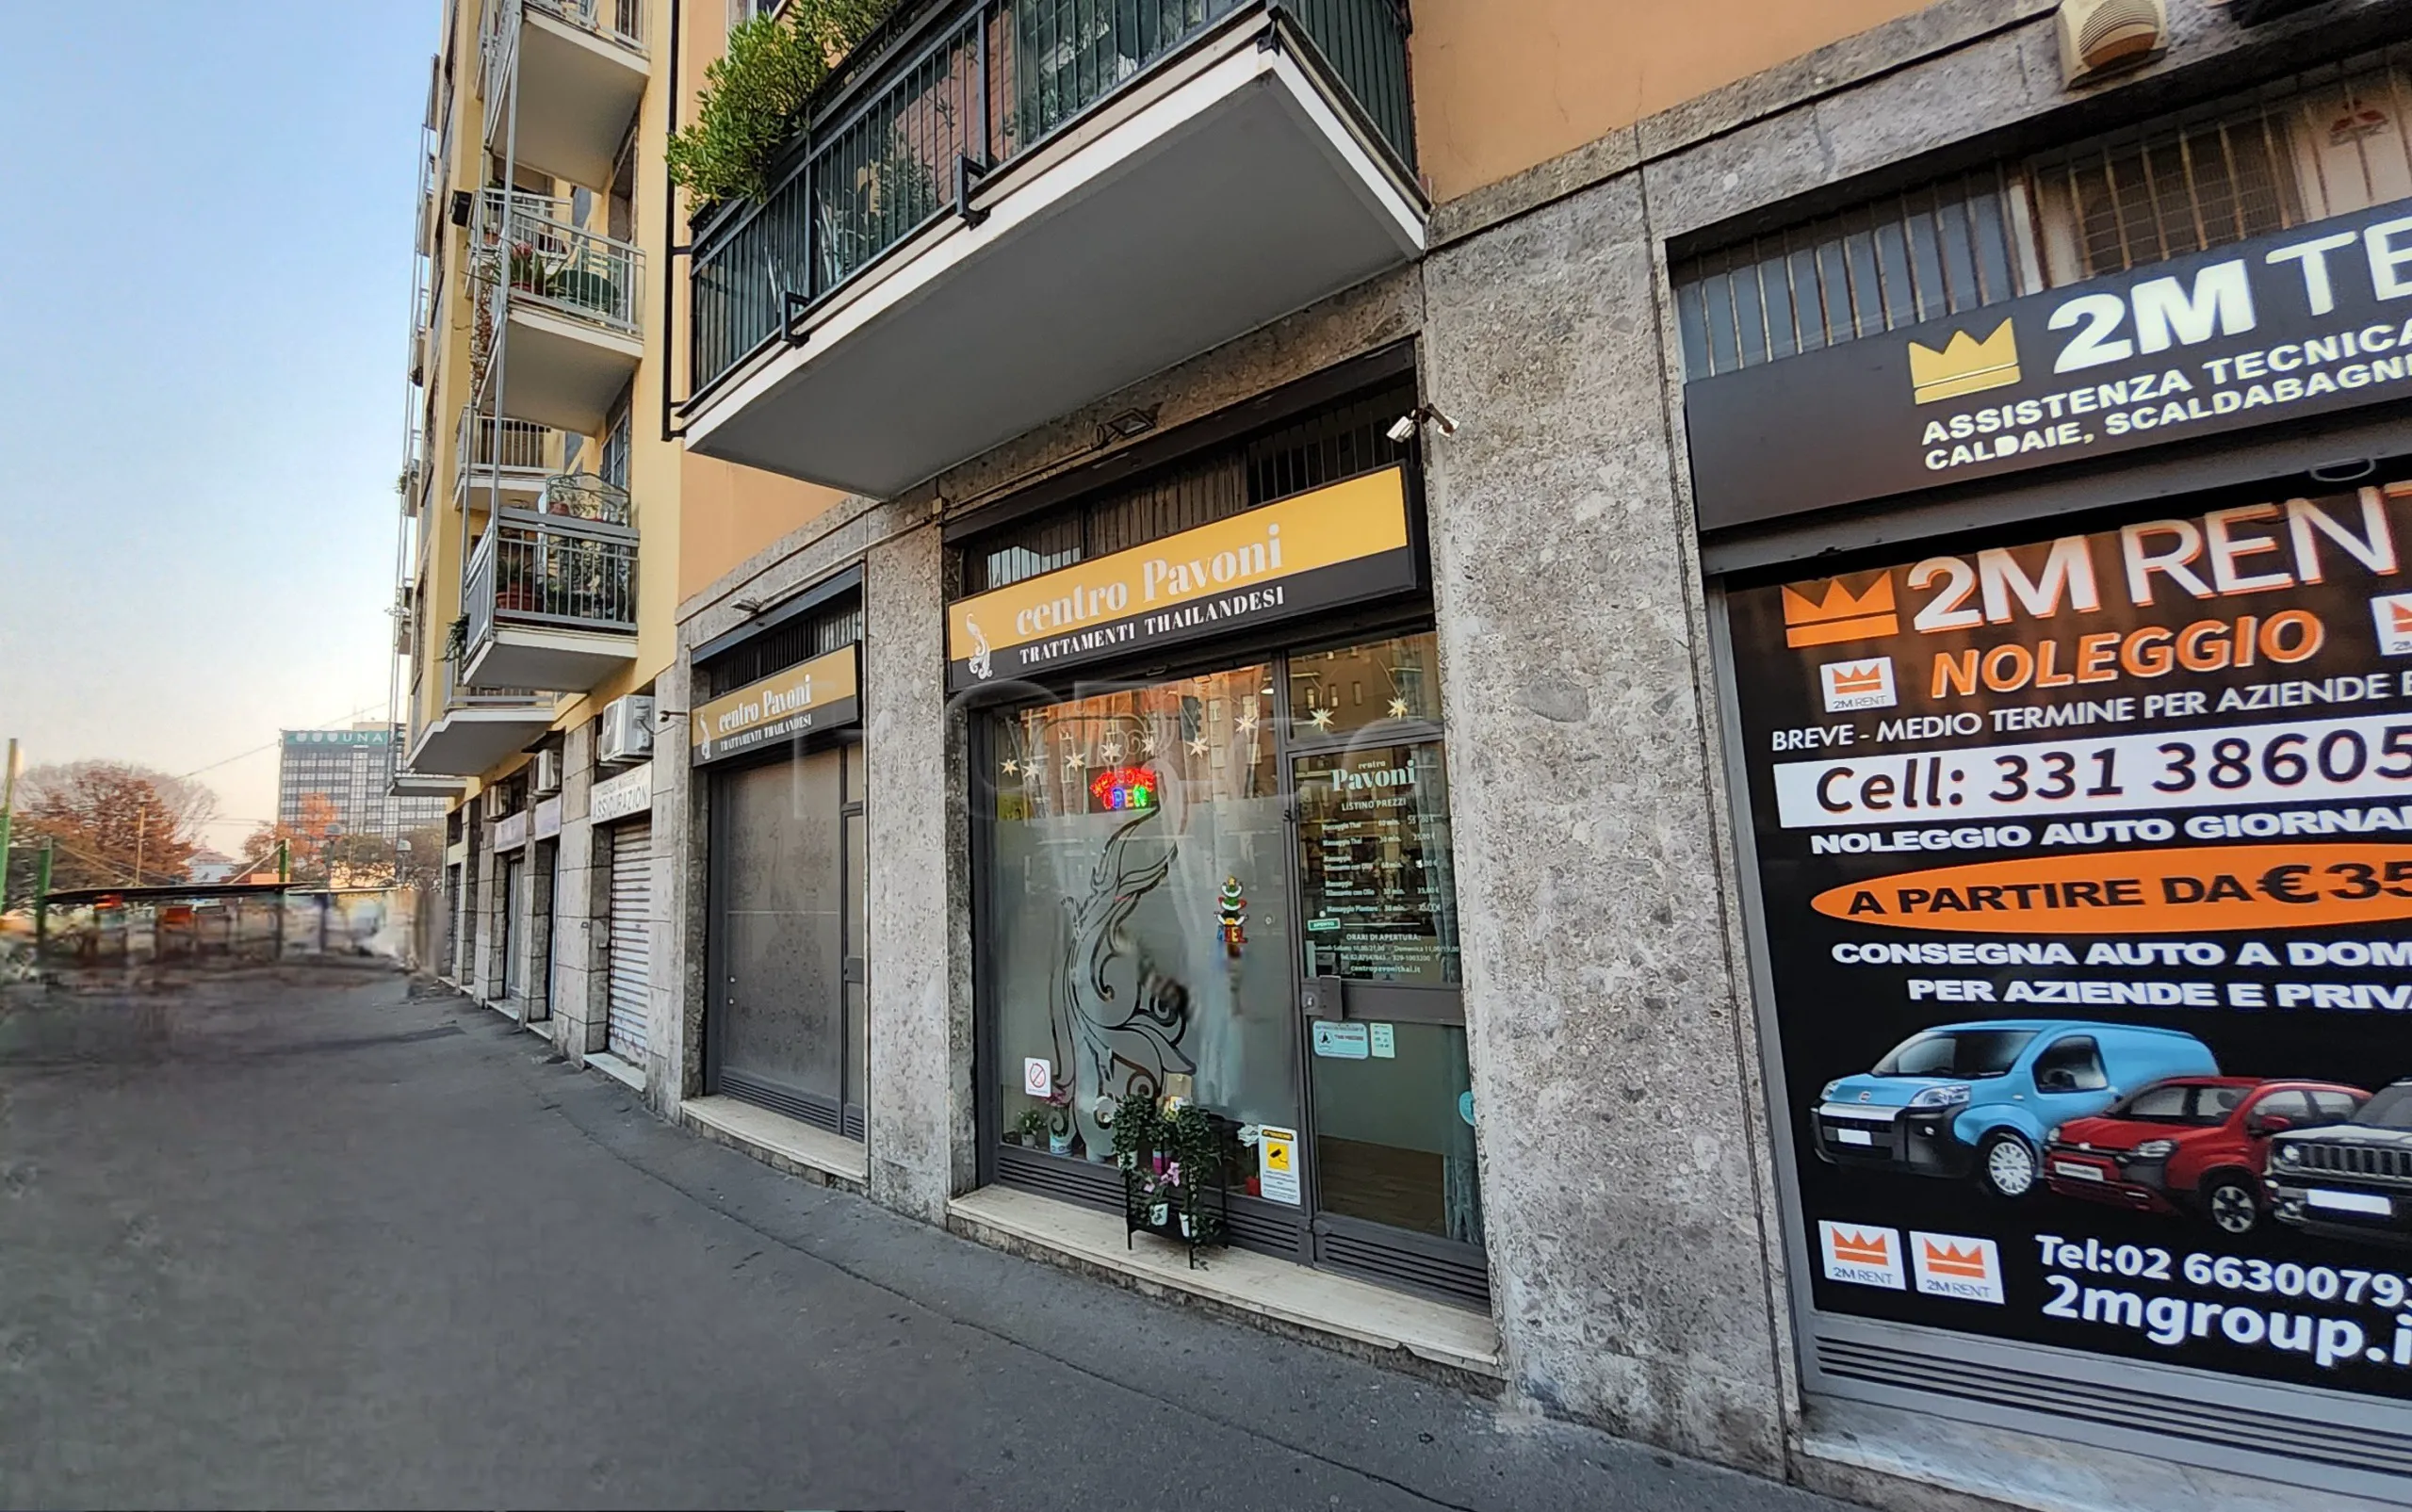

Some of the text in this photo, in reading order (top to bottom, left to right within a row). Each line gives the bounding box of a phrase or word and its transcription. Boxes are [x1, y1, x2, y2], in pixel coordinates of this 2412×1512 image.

[2047, 216, 2412, 374] 2M TE
[1921, 369, 2193, 447] ASSISTENZA
[1925, 420, 2094, 472] CALDAIE,
[1016, 523, 1284, 637] centro Pavoni
[1907, 534, 2101, 634] 2M
[1019, 587, 1285, 665] TRATTAMENTI THAILANDESI
[1931, 609, 2326, 700] NOLEGGIO
[718, 674, 812, 734] centro Pavoni
[1771, 723, 1854, 753] BREVE
[1876, 711, 1981, 743] MEDIO
[1990, 696, 2135, 734] TERMINE
[2144, 690, 2210, 720] PER
[2218, 673, 2391, 712] AZIENDE
[1833, 695, 1887, 709] 2M RENT
[719, 713, 813, 753] TRATTAMENTI THAILANDESI
[1330, 759, 1416, 792] Pavoni
[1359, 760, 1386, 770] centro
[1816, 724, 2412, 813] Cell: 331 38605
[1342, 798, 1407, 811] LISTINO PREZZI
[1810, 805, 2412, 855] NOLEGGIO AUTO GIORNA
[1847, 889, 1885, 918] A
[1899, 877, 2143, 917] PARTIRE
[2160, 874, 2252, 906] DA
[1831, 941, 2071, 968] CONSEGNA
[2082, 941, 2225, 967] AUTO
[2232, 942, 2280, 967] A
[1908, 978, 2412, 1011] PER AZIENDE E PRIV
[1833, 1267, 1894, 1285] 2M RENT
[2034, 1234, 2172, 1282] Tel:02
[1926, 1279, 1991, 1298] 2M RENT
[2042, 1274, 2412, 1368] 2mgroup.i
